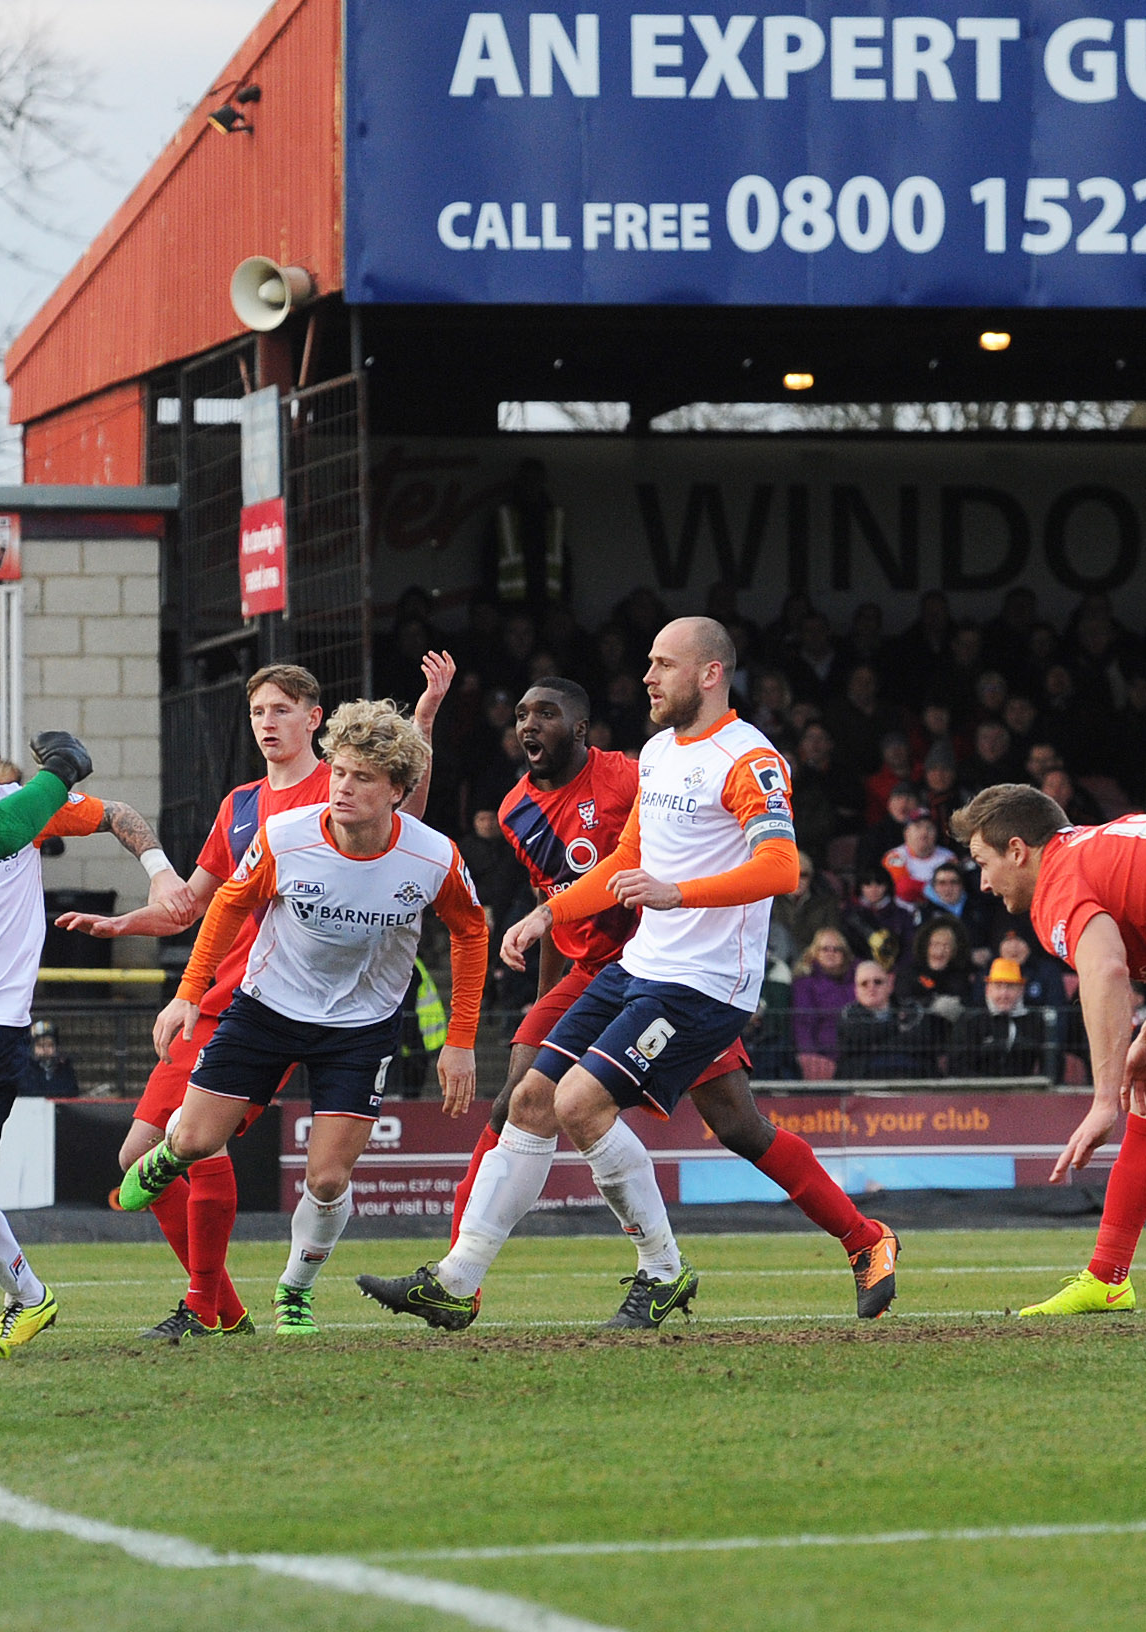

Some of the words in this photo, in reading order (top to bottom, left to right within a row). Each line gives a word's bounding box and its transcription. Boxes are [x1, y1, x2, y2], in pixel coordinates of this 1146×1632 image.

[449, 12, 600, 98] AN
[631, 14, 1021, 102] EXPERT
[437, 201, 571, 252] CALL
[582, 202, 711, 252] FREE
[725, 174, 946, 254] 0800
[969, 176, 1146, 255] 152
[297, 881, 321, 894] FILA
[320, 905, 417, 928] BARNFIELD
[636, 1017, 677, 1060] 6
[627, 1048, 649, 1071] FILA
[864, 1111, 926, 1137] your
[932, 1107, 990, 1132] club
[379, 1180, 406, 1193] from
[357, 1201, 391, 1217] your
[393, 1199, 423, 1215] visit
[426, 1200, 441, 1215] to
